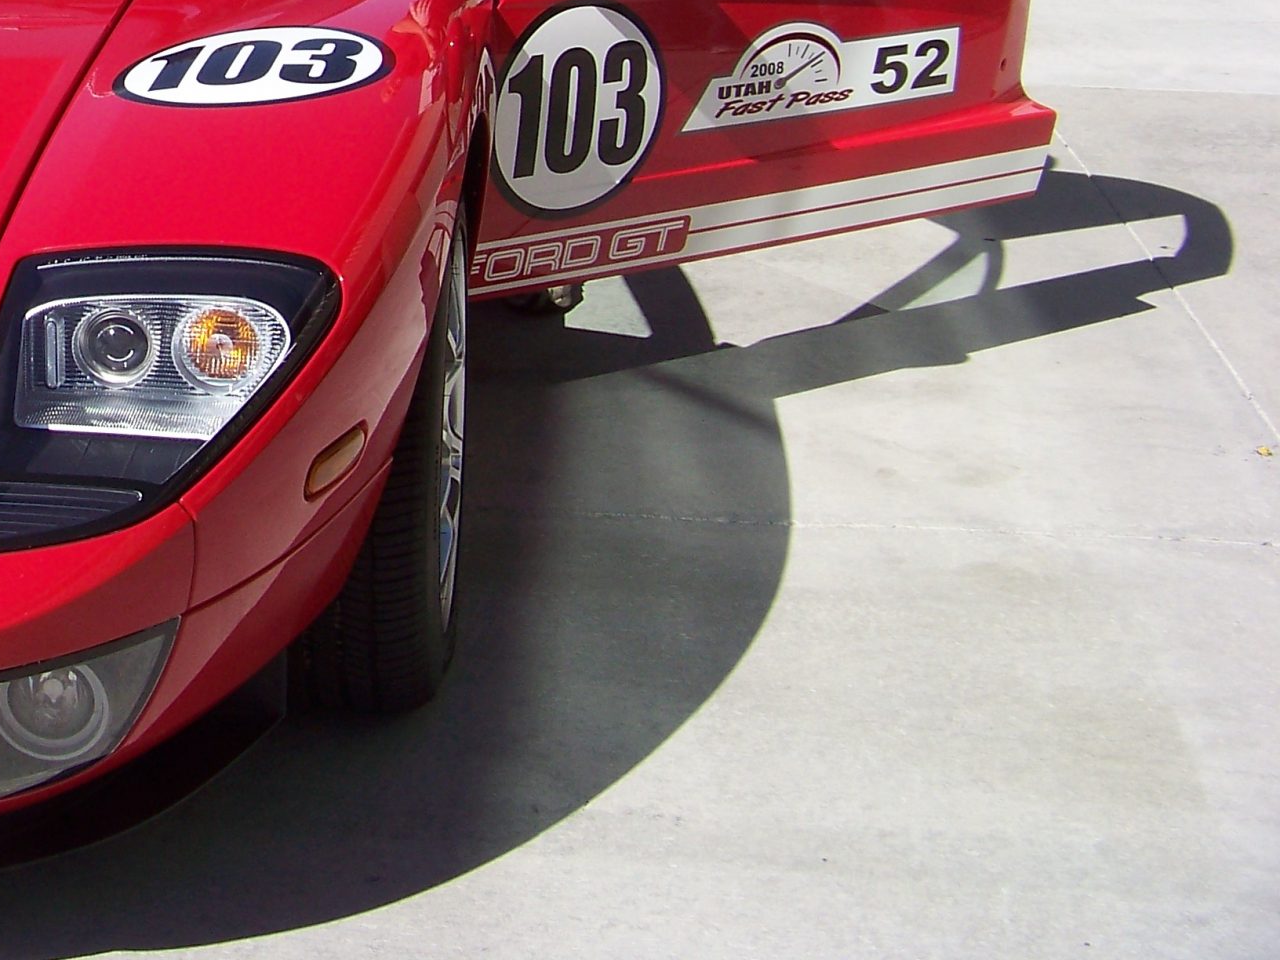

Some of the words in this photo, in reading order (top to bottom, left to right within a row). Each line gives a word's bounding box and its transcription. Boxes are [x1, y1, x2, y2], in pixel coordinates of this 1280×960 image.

[147, 38, 364, 92] 103
[750, 61, 784, 78] 2008
[870, 39, 950, 95] 52
[508, 40, 648, 179] 103
[715, 94, 785, 119] Fast
[785, 89, 853, 110] Pass
[718, 80, 771, 100] UTAH
[608, 220, 685, 260] GT
